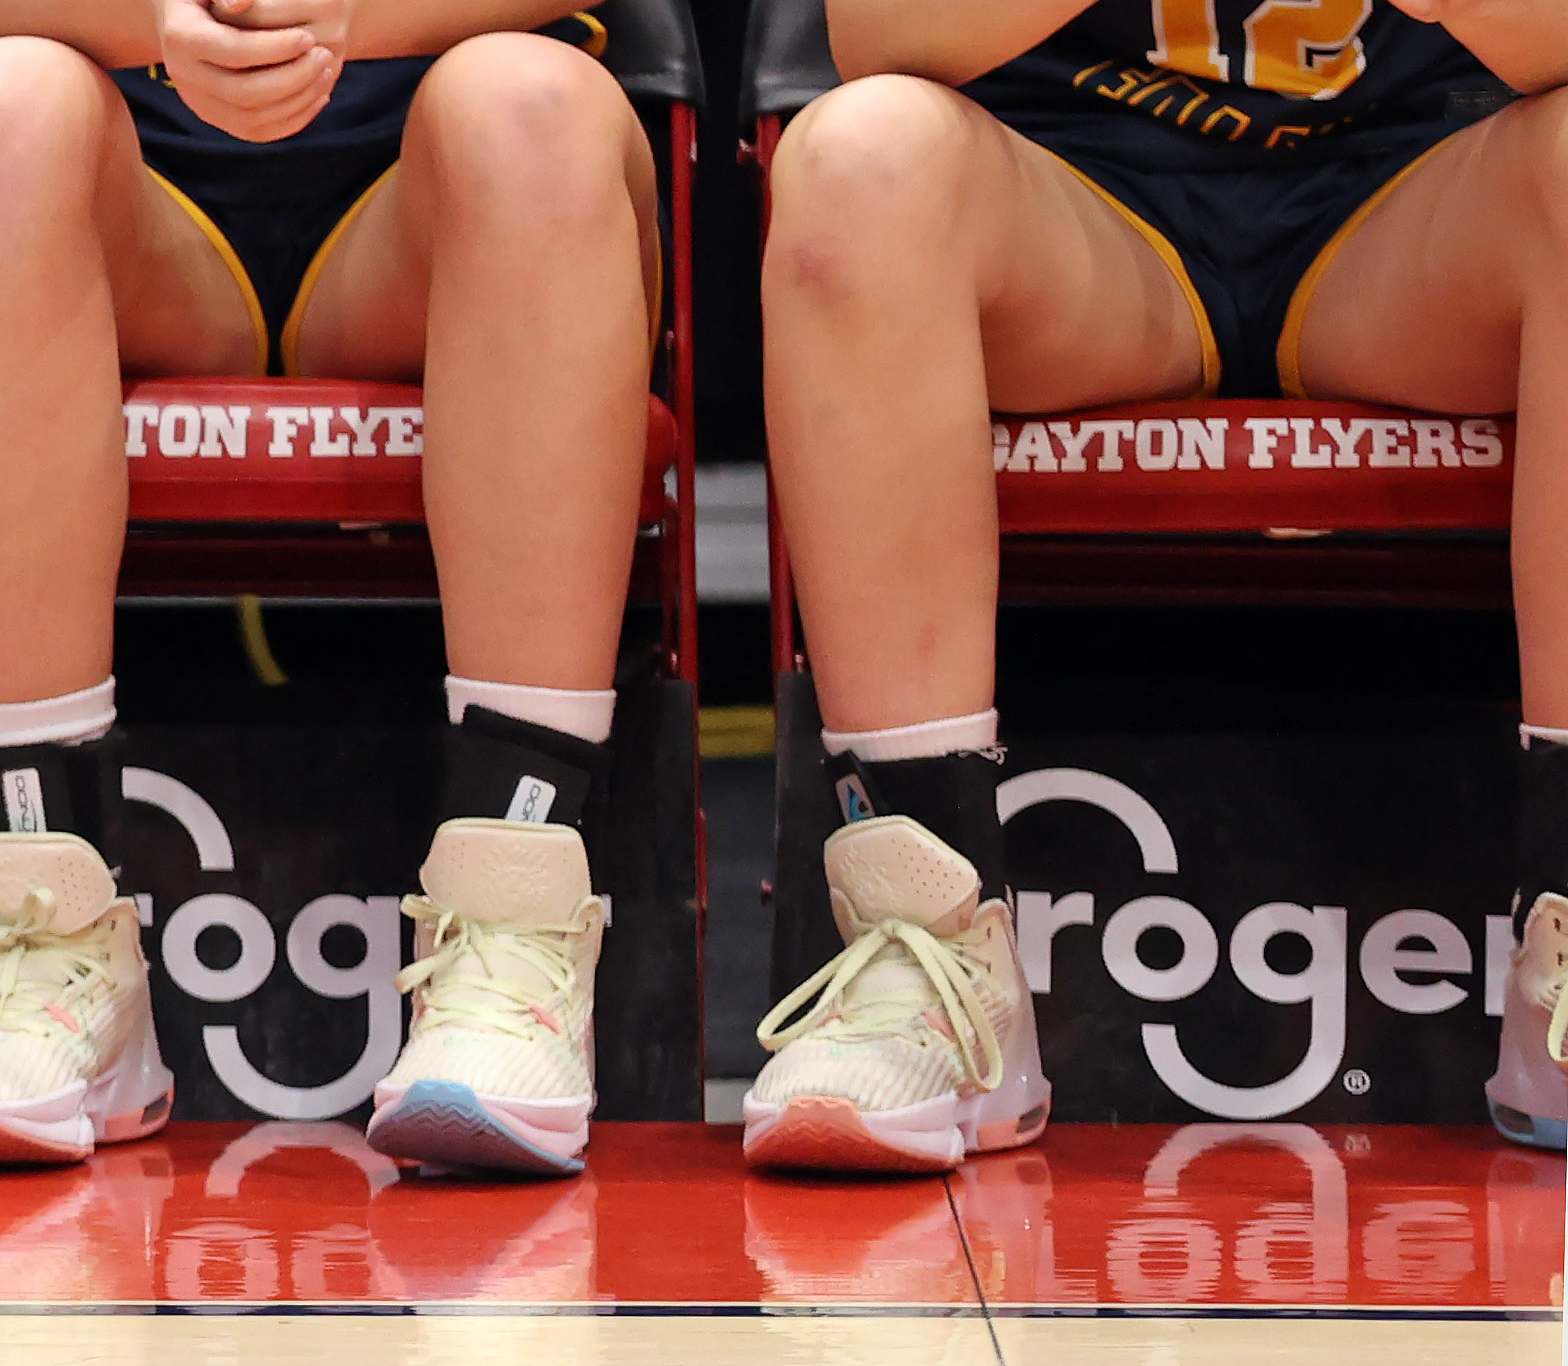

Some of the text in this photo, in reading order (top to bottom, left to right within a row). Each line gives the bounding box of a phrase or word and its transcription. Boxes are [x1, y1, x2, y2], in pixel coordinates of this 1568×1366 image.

[123, 404, 424, 458] TON FLYE
[1245, 417, 1504, 468] FLYERS
